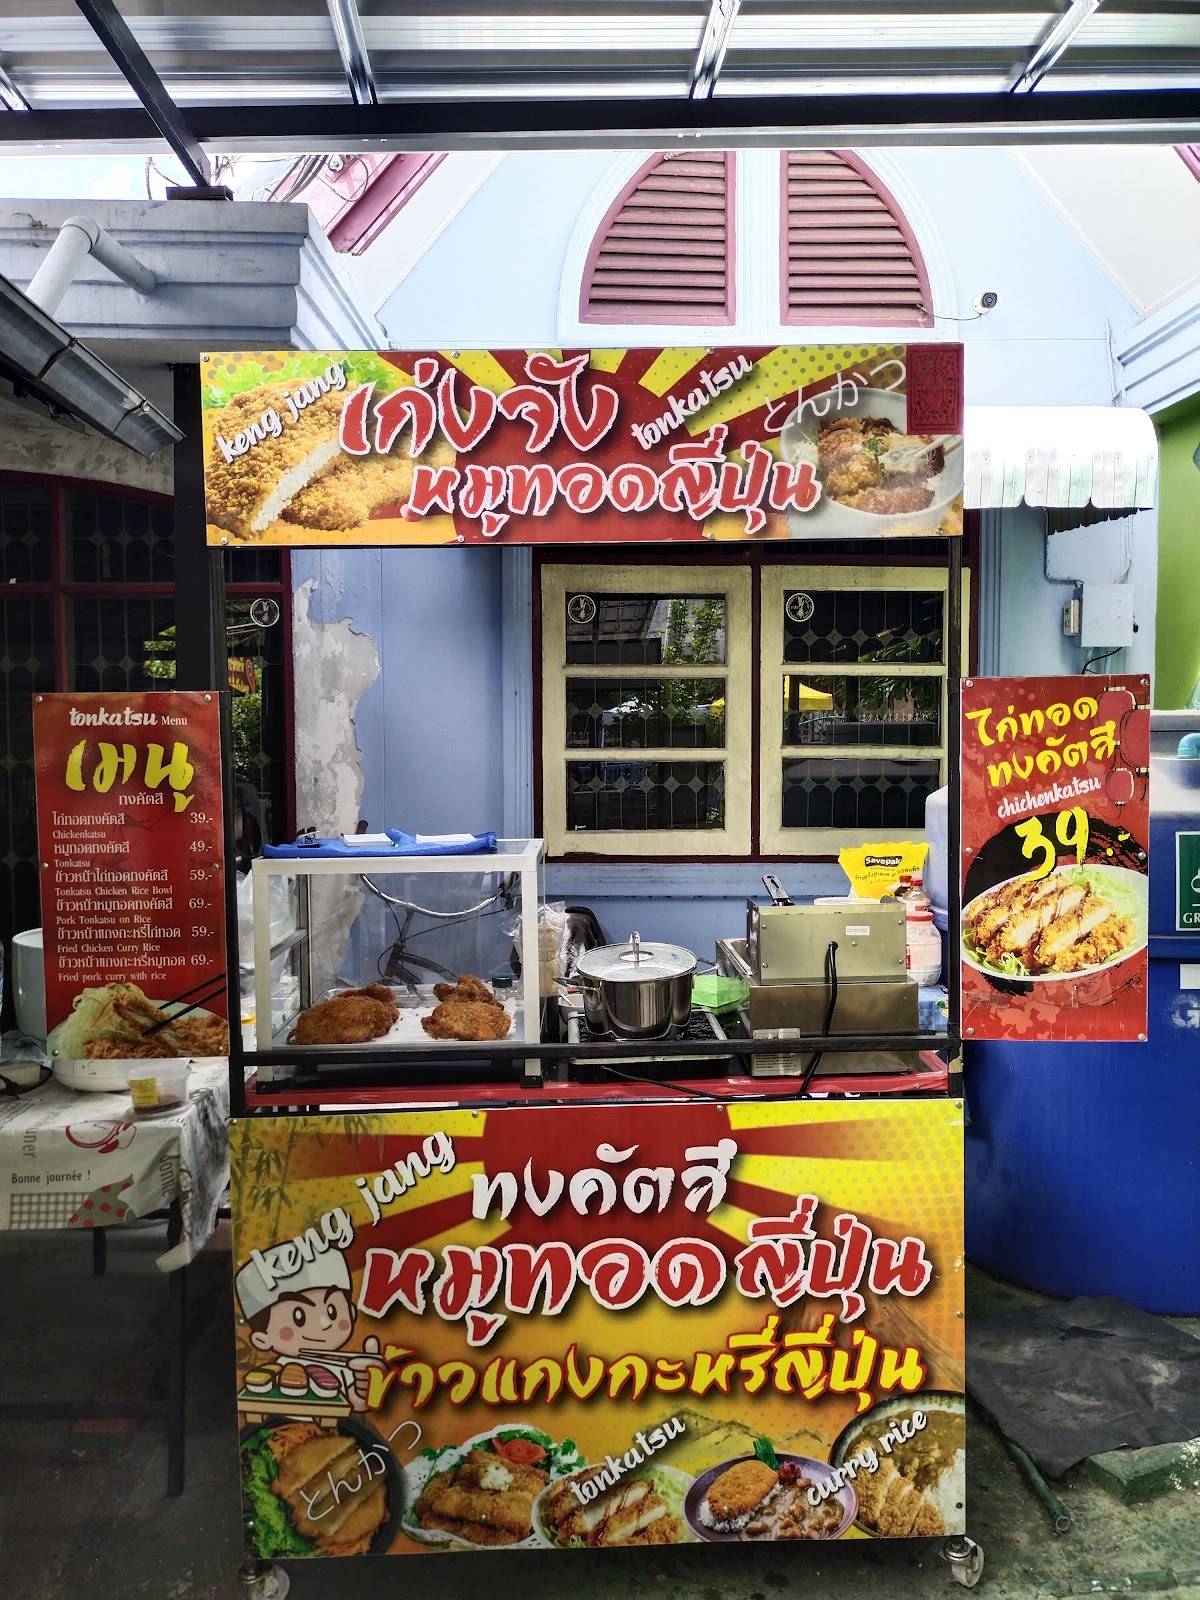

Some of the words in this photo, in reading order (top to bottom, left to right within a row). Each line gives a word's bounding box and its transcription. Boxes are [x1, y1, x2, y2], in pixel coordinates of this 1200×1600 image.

[216, 406, 284, 464] keng
[284, 360, 347, 420] jang
[338, 352, 619, 458] เก่งจัง
[631, 354, 753, 450] tonkatsu
[763, 359, 907, 433] とんかつ
[406, 424, 822, 536] หมูทอดญี่ปุ่น
[69, 707, 158, 726] tonkatsu
[161, 716, 188, 726] Menu
[965, 696, 1098, 747] ไก่ทอด
[65, 739, 195, 813] เมนู
[986, 720, 1117, 787] ทงคัตสึ
[190, 812, 214, 823] 39.-
[997, 777, 1102, 819] chichenkatsu
[53, 830, 106, 839] Chickenkatsu
[190, 841, 213, 852] 49.-
[1014, 807, 1090, 882] 39
[54, 859, 91, 868] Tonkatsu
[189, 869, 213, 881] 59.-
[55, 887, 92, 897] Tonkatsu
[95, 886, 128, 896] Chicken
[131, 886, 149, 895] Rice
[152, 885, 173, 895] Bowl
[189, 898, 213, 909] 69.-
[56, 916, 76, 925] Pork
[79, 915, 116, 925] Tonkatsu
[134, 915, 151, 924] Rice
[191, 926, 215, 938] 59.-
[57, 944, 78, 953] Fried
[81, 943, 113, 953] Chicken
[117, 943, 139, 954] Curry
[143, 943, 161, 952] Rice
[190, 954, 214, 966] 69.-
[58, 973, 79, 982] Fried
[82, 972, 102, 983] pork
[105, 973, 127, 983] curry
[130, 971, 147, 981] with
[151, 971, 167, 981] rice
[11, 1172, 41, 1185] Bonne
[46, 1170, 83, 1186] journée
[470, 1138, 738, 1220] ทงคัตสึ
[249, 1207, 356, 1291] keng
[354, 1131, 456, 1227] jang
[358, 1194, 933, 1347] หมูทอดญี่ปุ่น
[299, 1420, 423, 1521] とんかつ
[569, 1415, 687, 1507] tonkatsu
[806, 1446, 881, 1507] curry
[878, 1409, 928, 1454] rice
